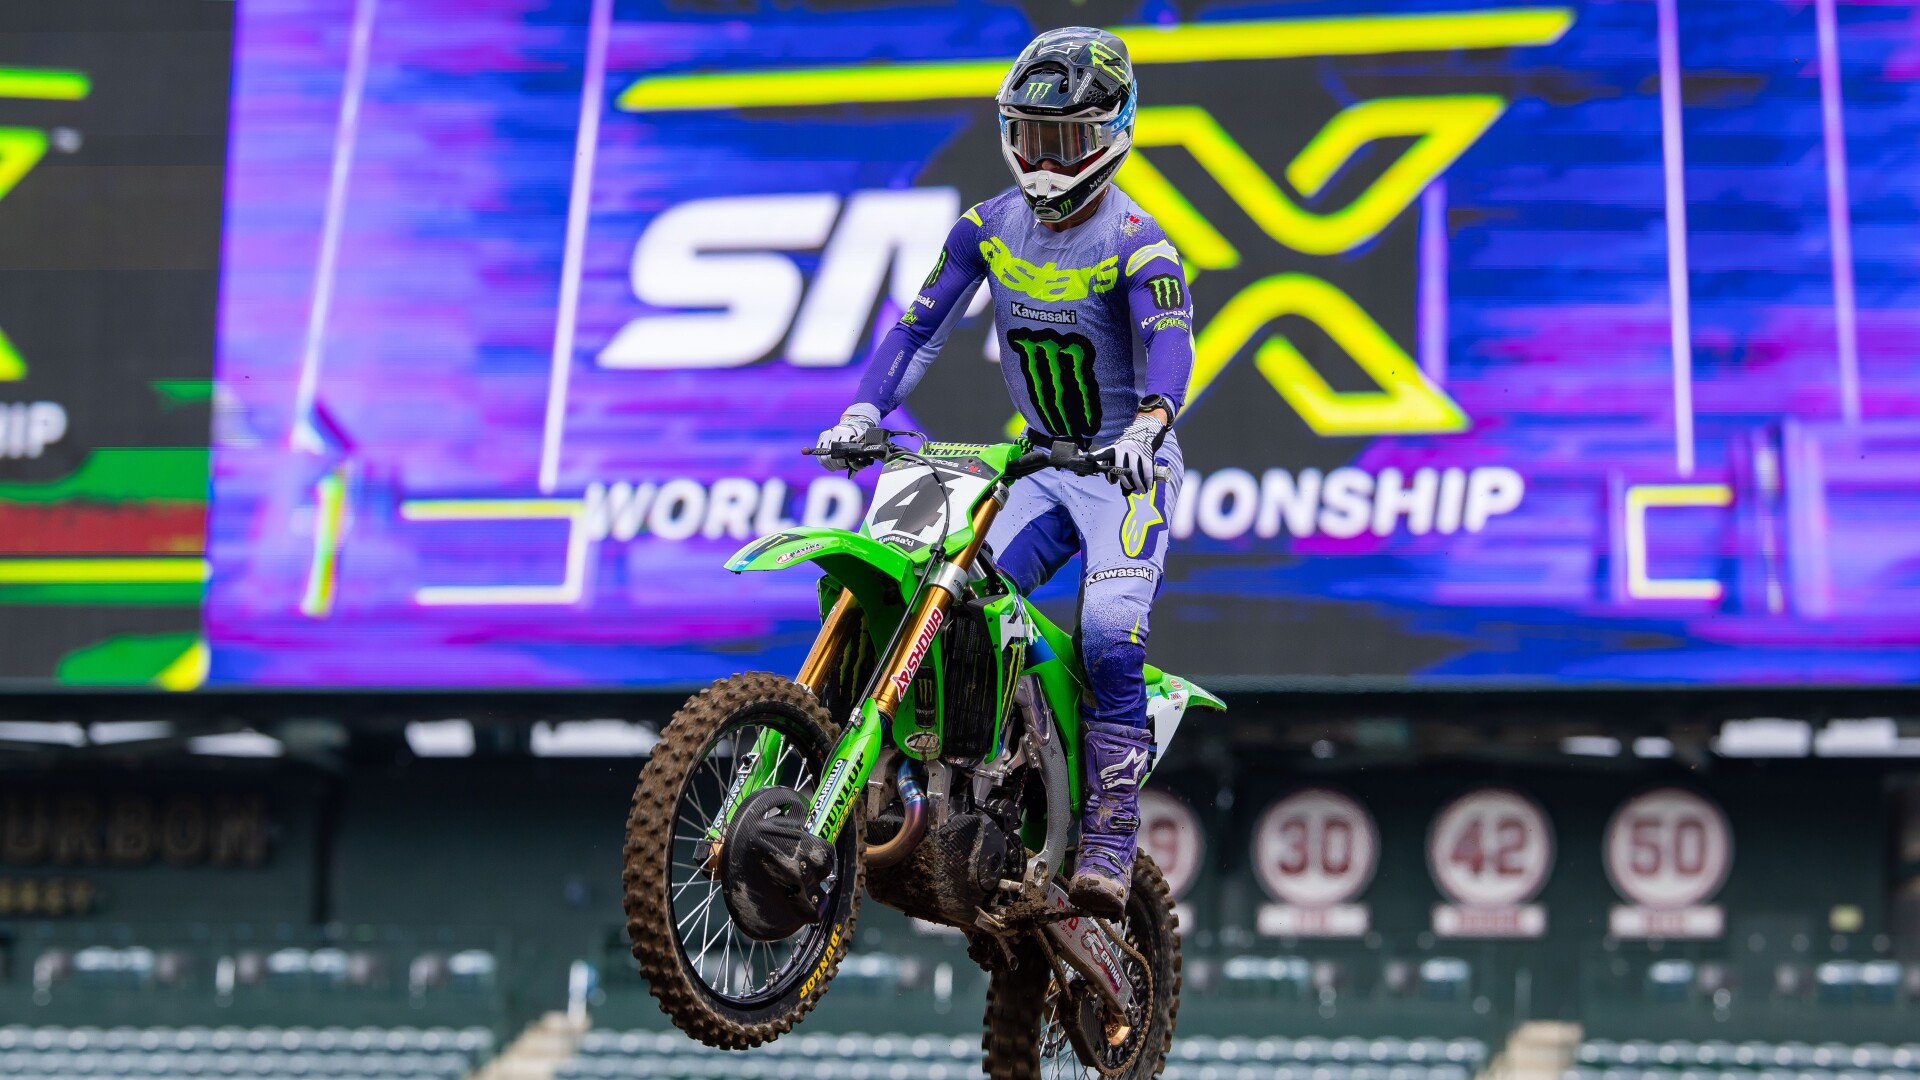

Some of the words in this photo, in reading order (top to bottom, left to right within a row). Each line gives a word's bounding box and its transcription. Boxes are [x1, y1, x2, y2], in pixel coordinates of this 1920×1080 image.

[916, 294, 936, 310] saki
[1012, 302, 1077, 324] Kawasaki
[887, 349, 905, 377] SUPERTECH
[585, 476, 864, 542] WORLD
[1170, 466, 1525, 540] IONSHIP
[872, 471, 964, 537] 4
[1085, 566, 1154, 587] Kawasaki
[907, 608, 943, 676] SHOWA
[813, 760, 844, 812] CARRILLO
[819, 752, 864, 839] DUNLOP
[1278, 815, 1354, 877] 30
[1450, 814, 1528, 878] 42
[1630, 814, 1708, 878] 50
[799, 930, 840, 999] DUNLOP
